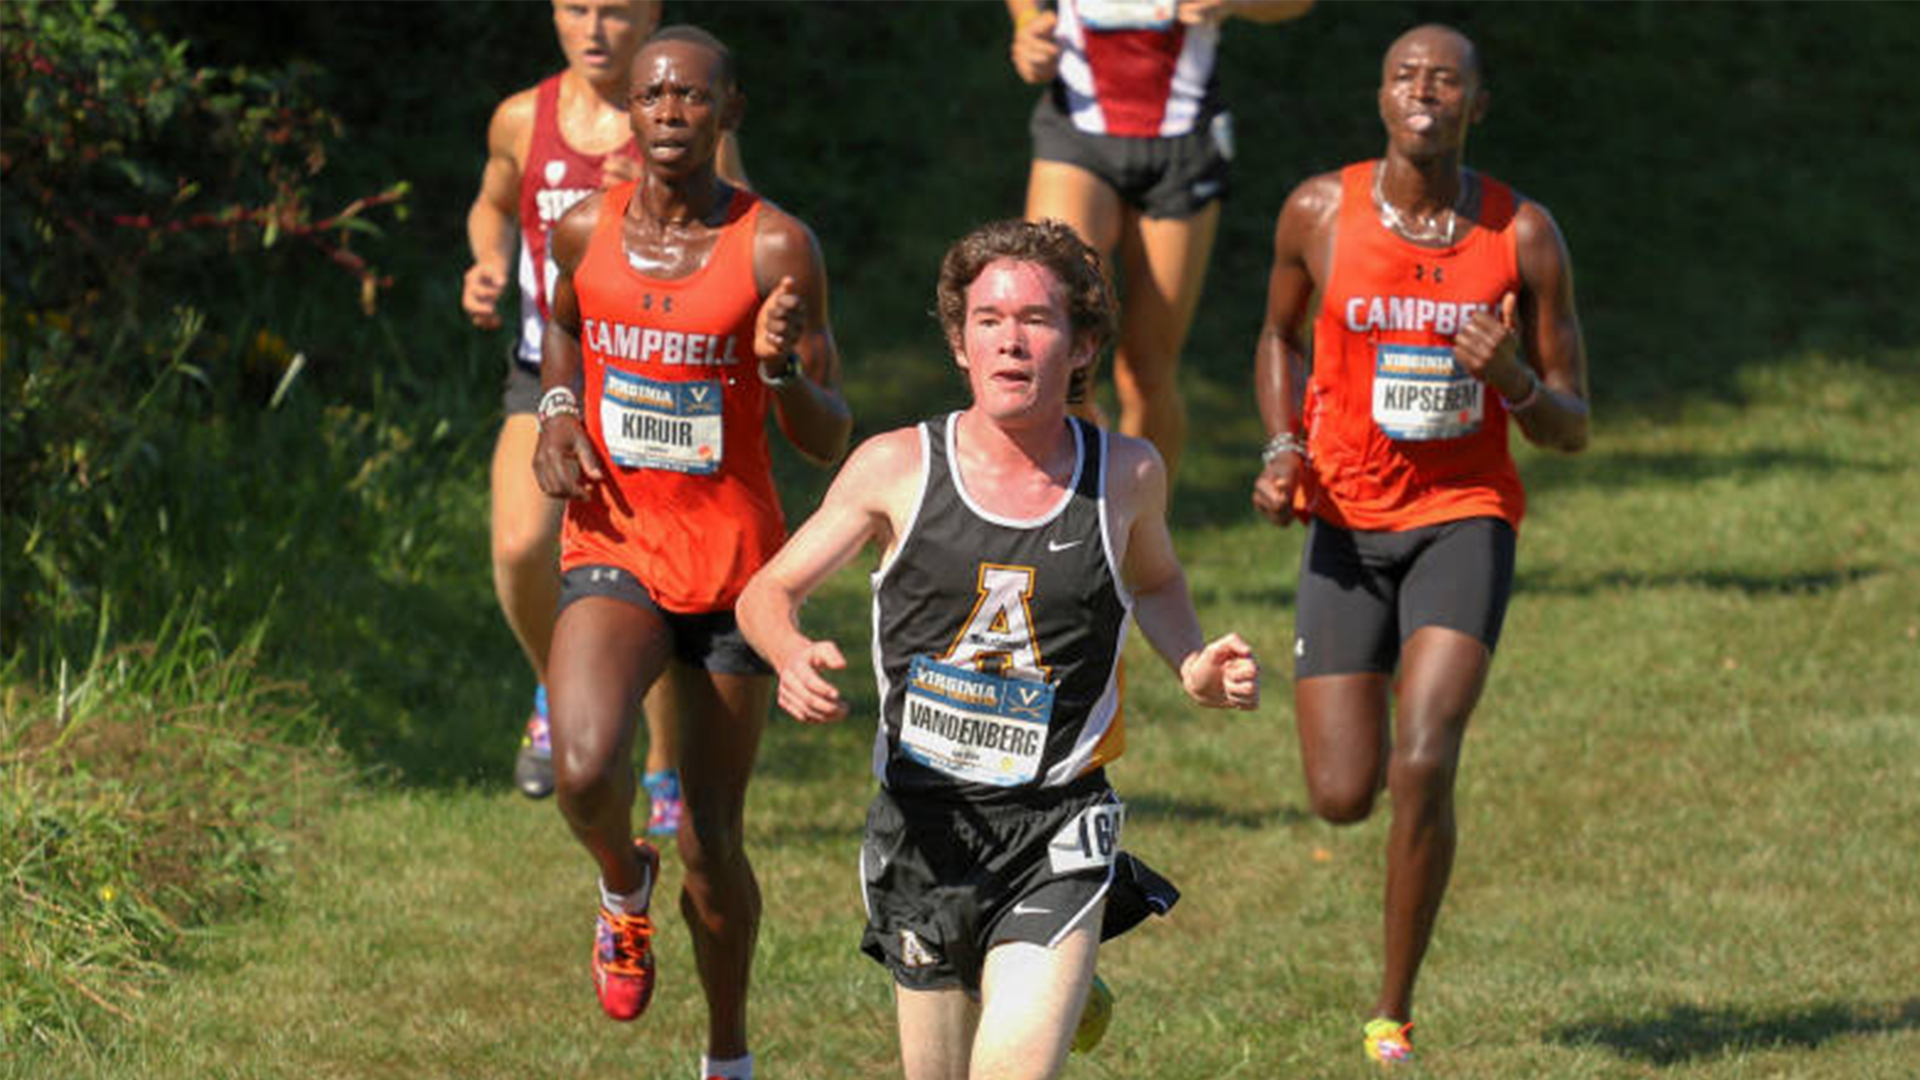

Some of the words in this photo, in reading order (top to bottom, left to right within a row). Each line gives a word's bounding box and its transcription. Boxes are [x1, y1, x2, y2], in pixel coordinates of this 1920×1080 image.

[585, 319, 739, 366] CAMPBELL
[621, 412, 693, 447] KIRUIR
[933, 561, 1053, 684] A
[915, 666, 998, 699] VIRGINIA
[1018, 687, 1041, 706] V
[909, 699, 1040, 757] VANDENBERG
